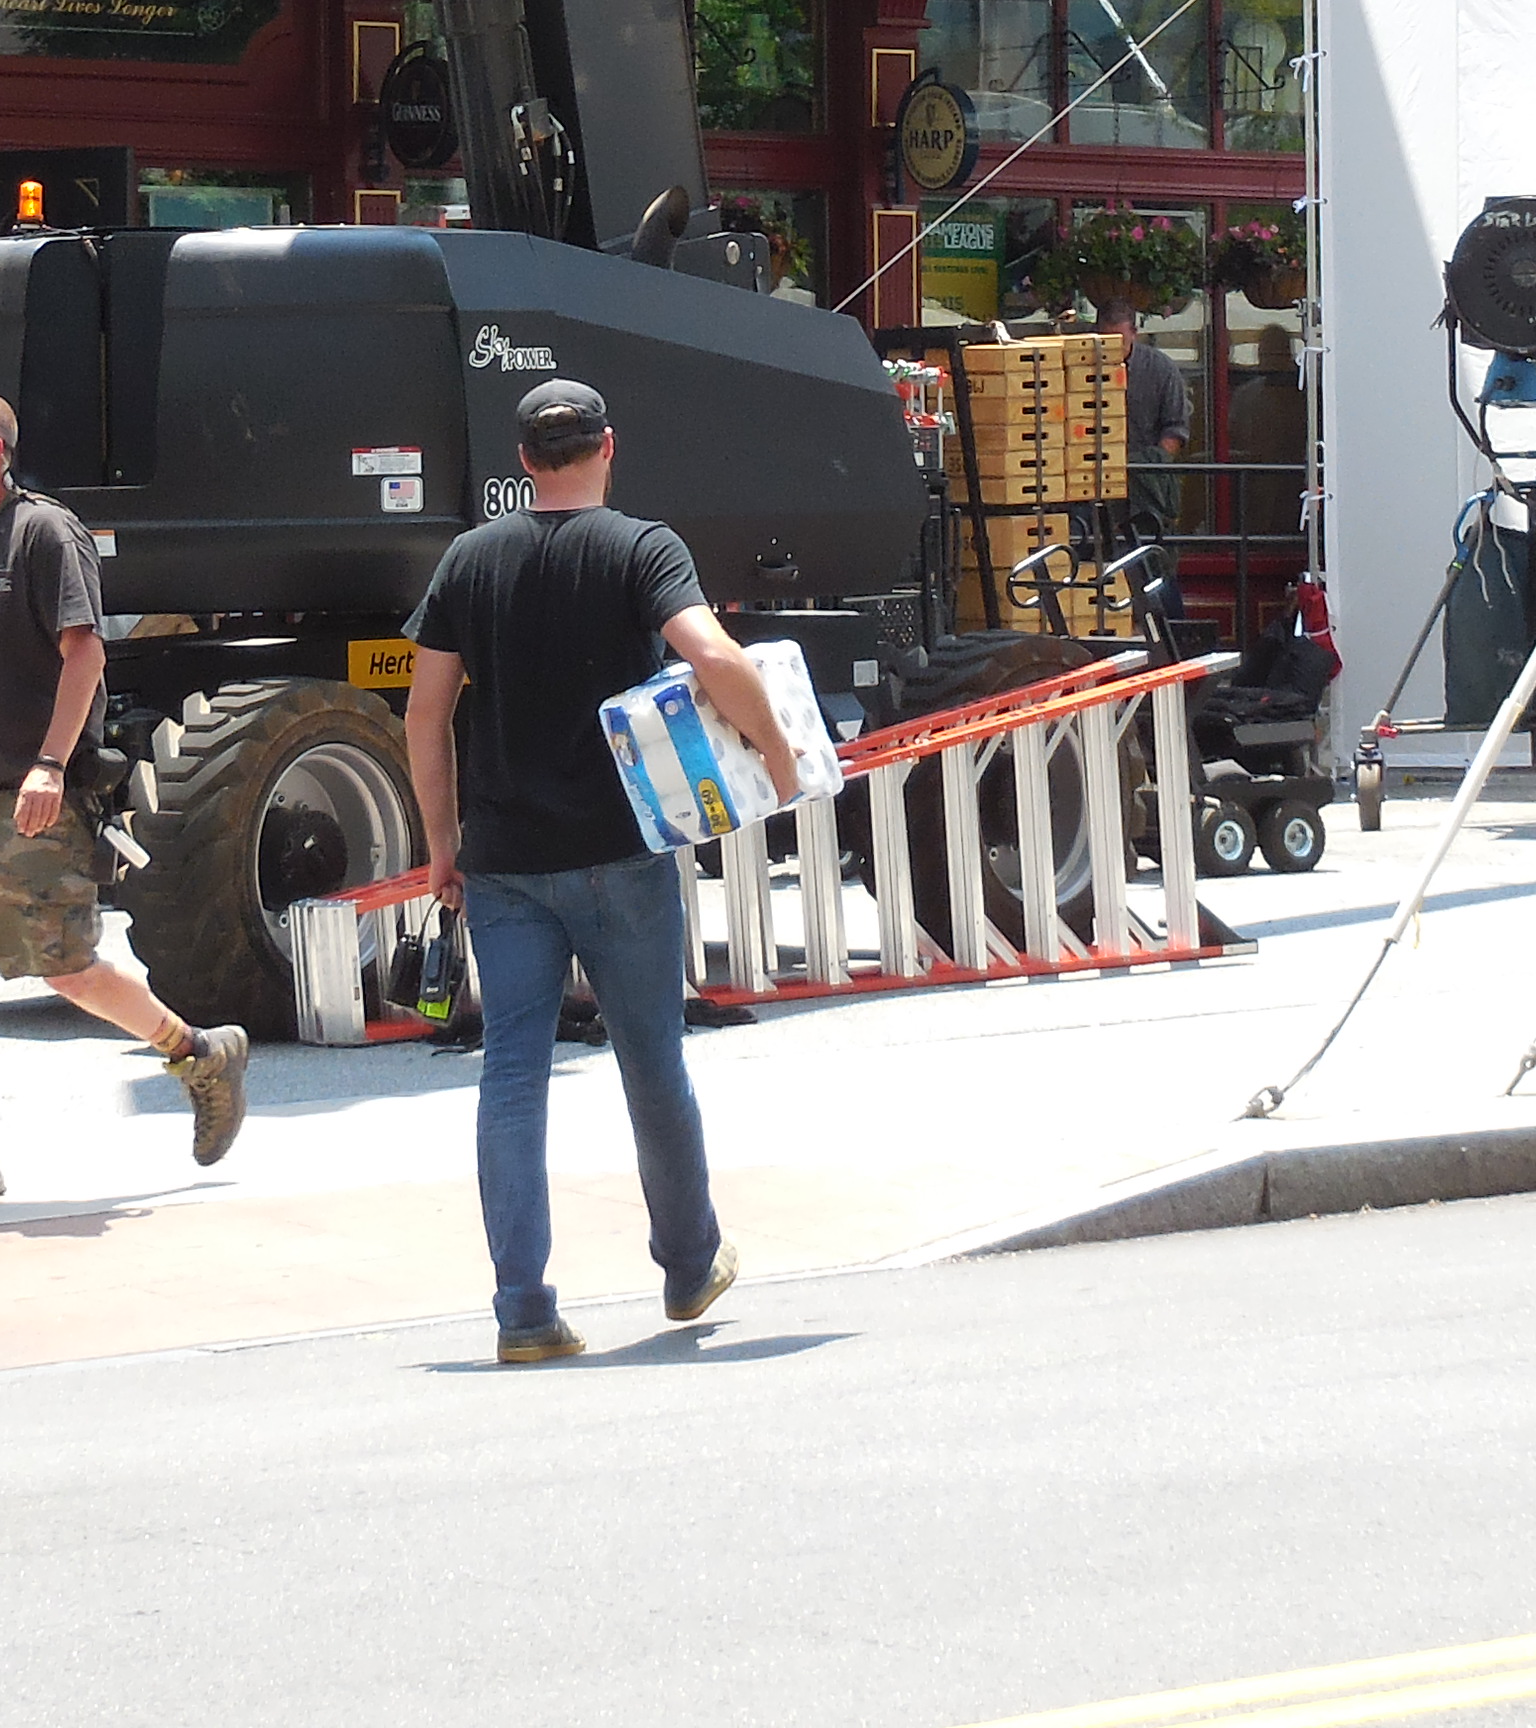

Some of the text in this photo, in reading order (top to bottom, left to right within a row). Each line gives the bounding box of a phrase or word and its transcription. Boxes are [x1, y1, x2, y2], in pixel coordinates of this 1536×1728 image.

[392, 102, 441, 122] GUINNESS
[909, 129, 954, 151] HARP
[468, 324, 557, 372] Sky POWER
